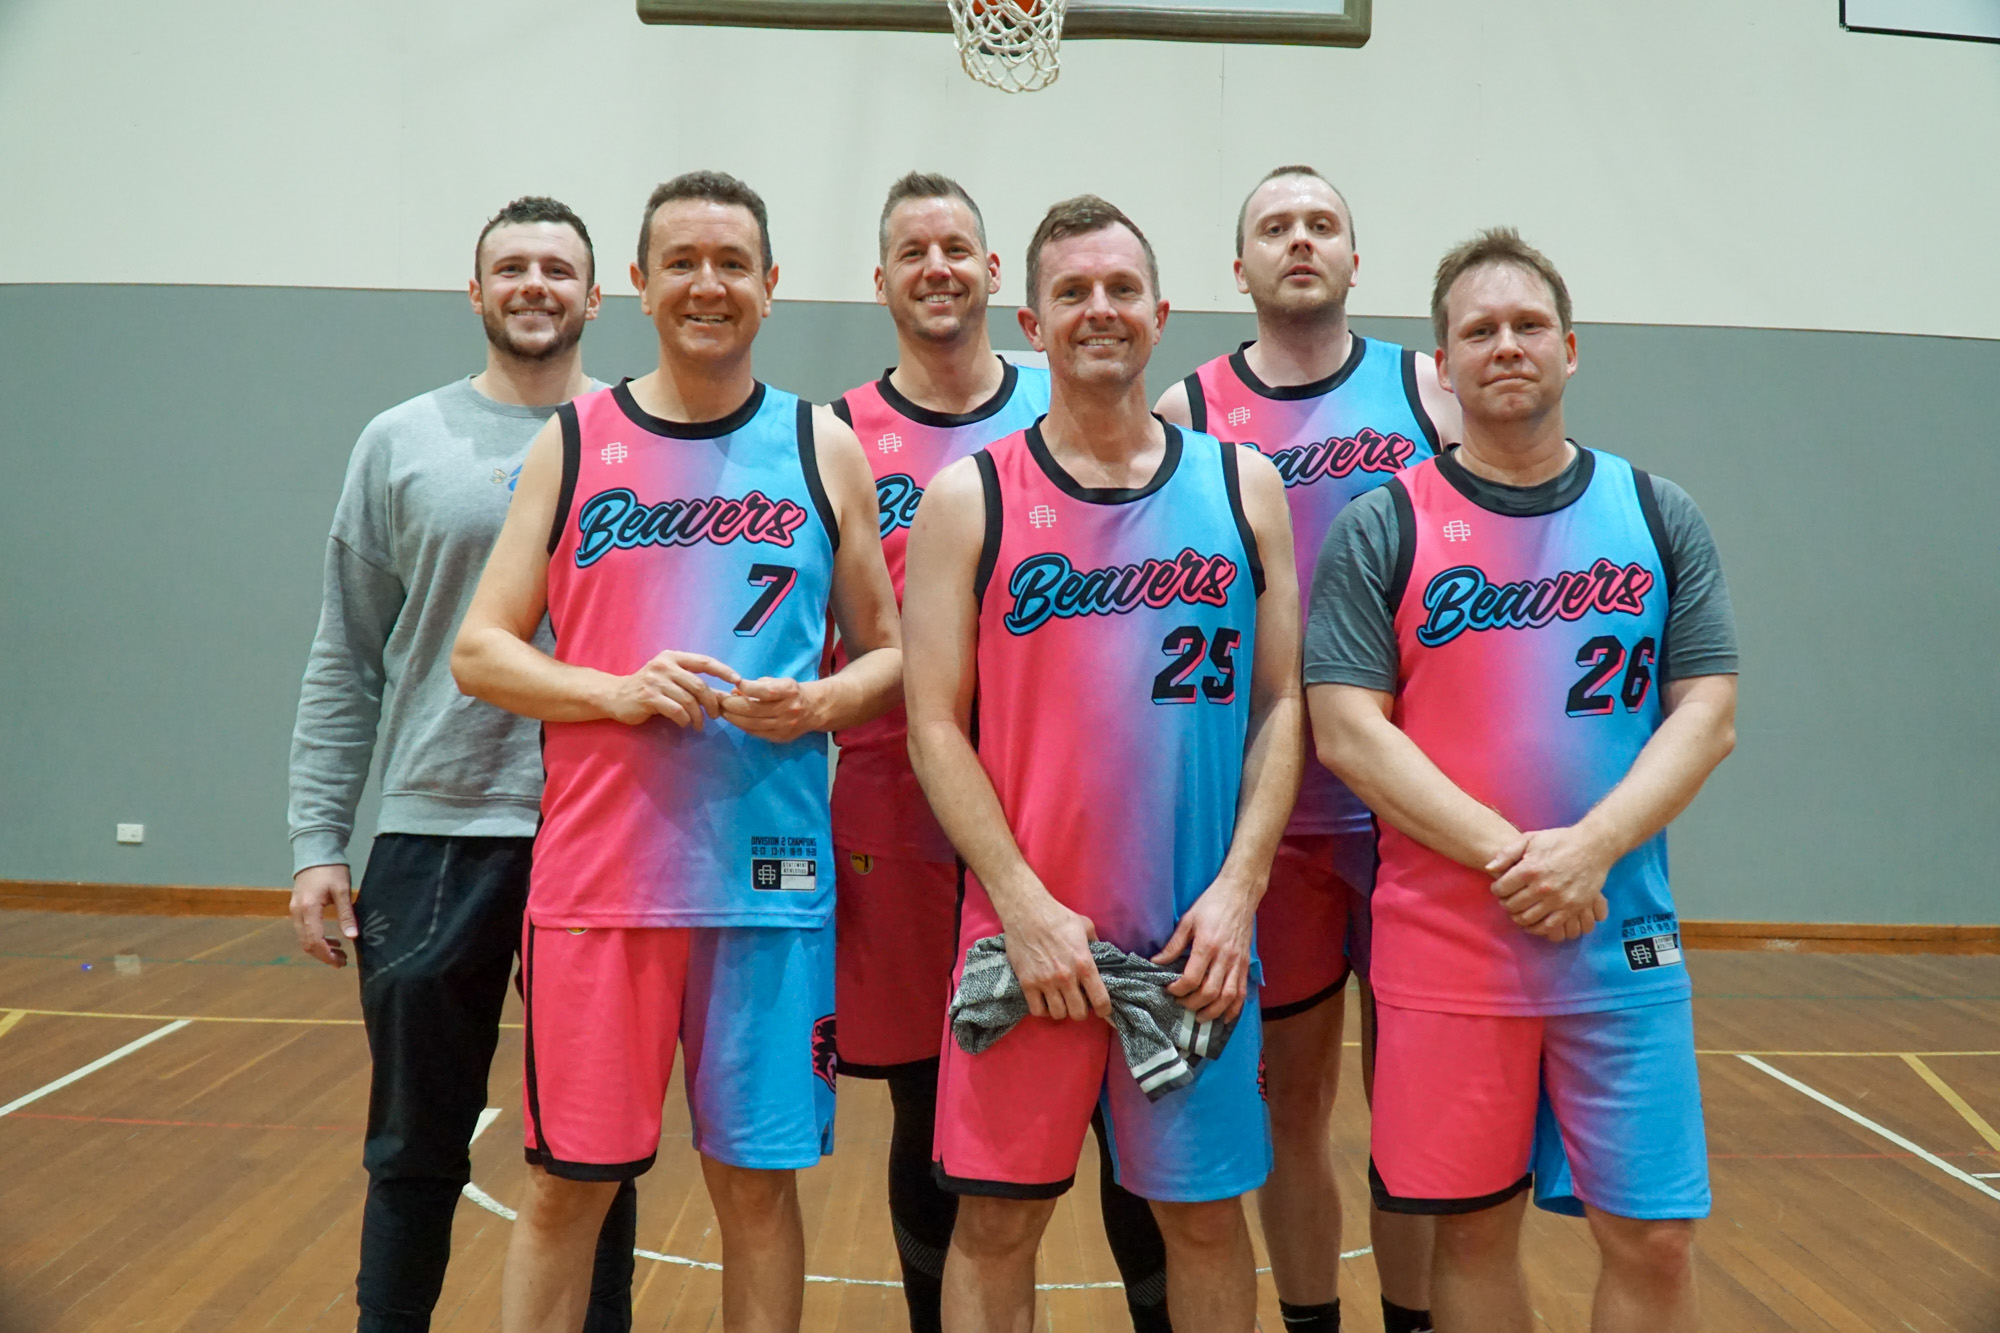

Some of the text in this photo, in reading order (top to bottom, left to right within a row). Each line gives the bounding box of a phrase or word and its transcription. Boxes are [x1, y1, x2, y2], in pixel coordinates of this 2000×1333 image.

[1240, 427, 1415, 488] avers
[575, 490, 807, 568] Beavers
[733, 563, 797, 637] 7
[1005, 547, 1236, 636] Beavers
[1416, 557, 1653, 648] Beavers
[1151, 626, 1241, 705] 25
[1565, 635, 1655, 718] 26
[751, 836, 779, 846] DIVISION
[781, 837, 786, 846] 2
